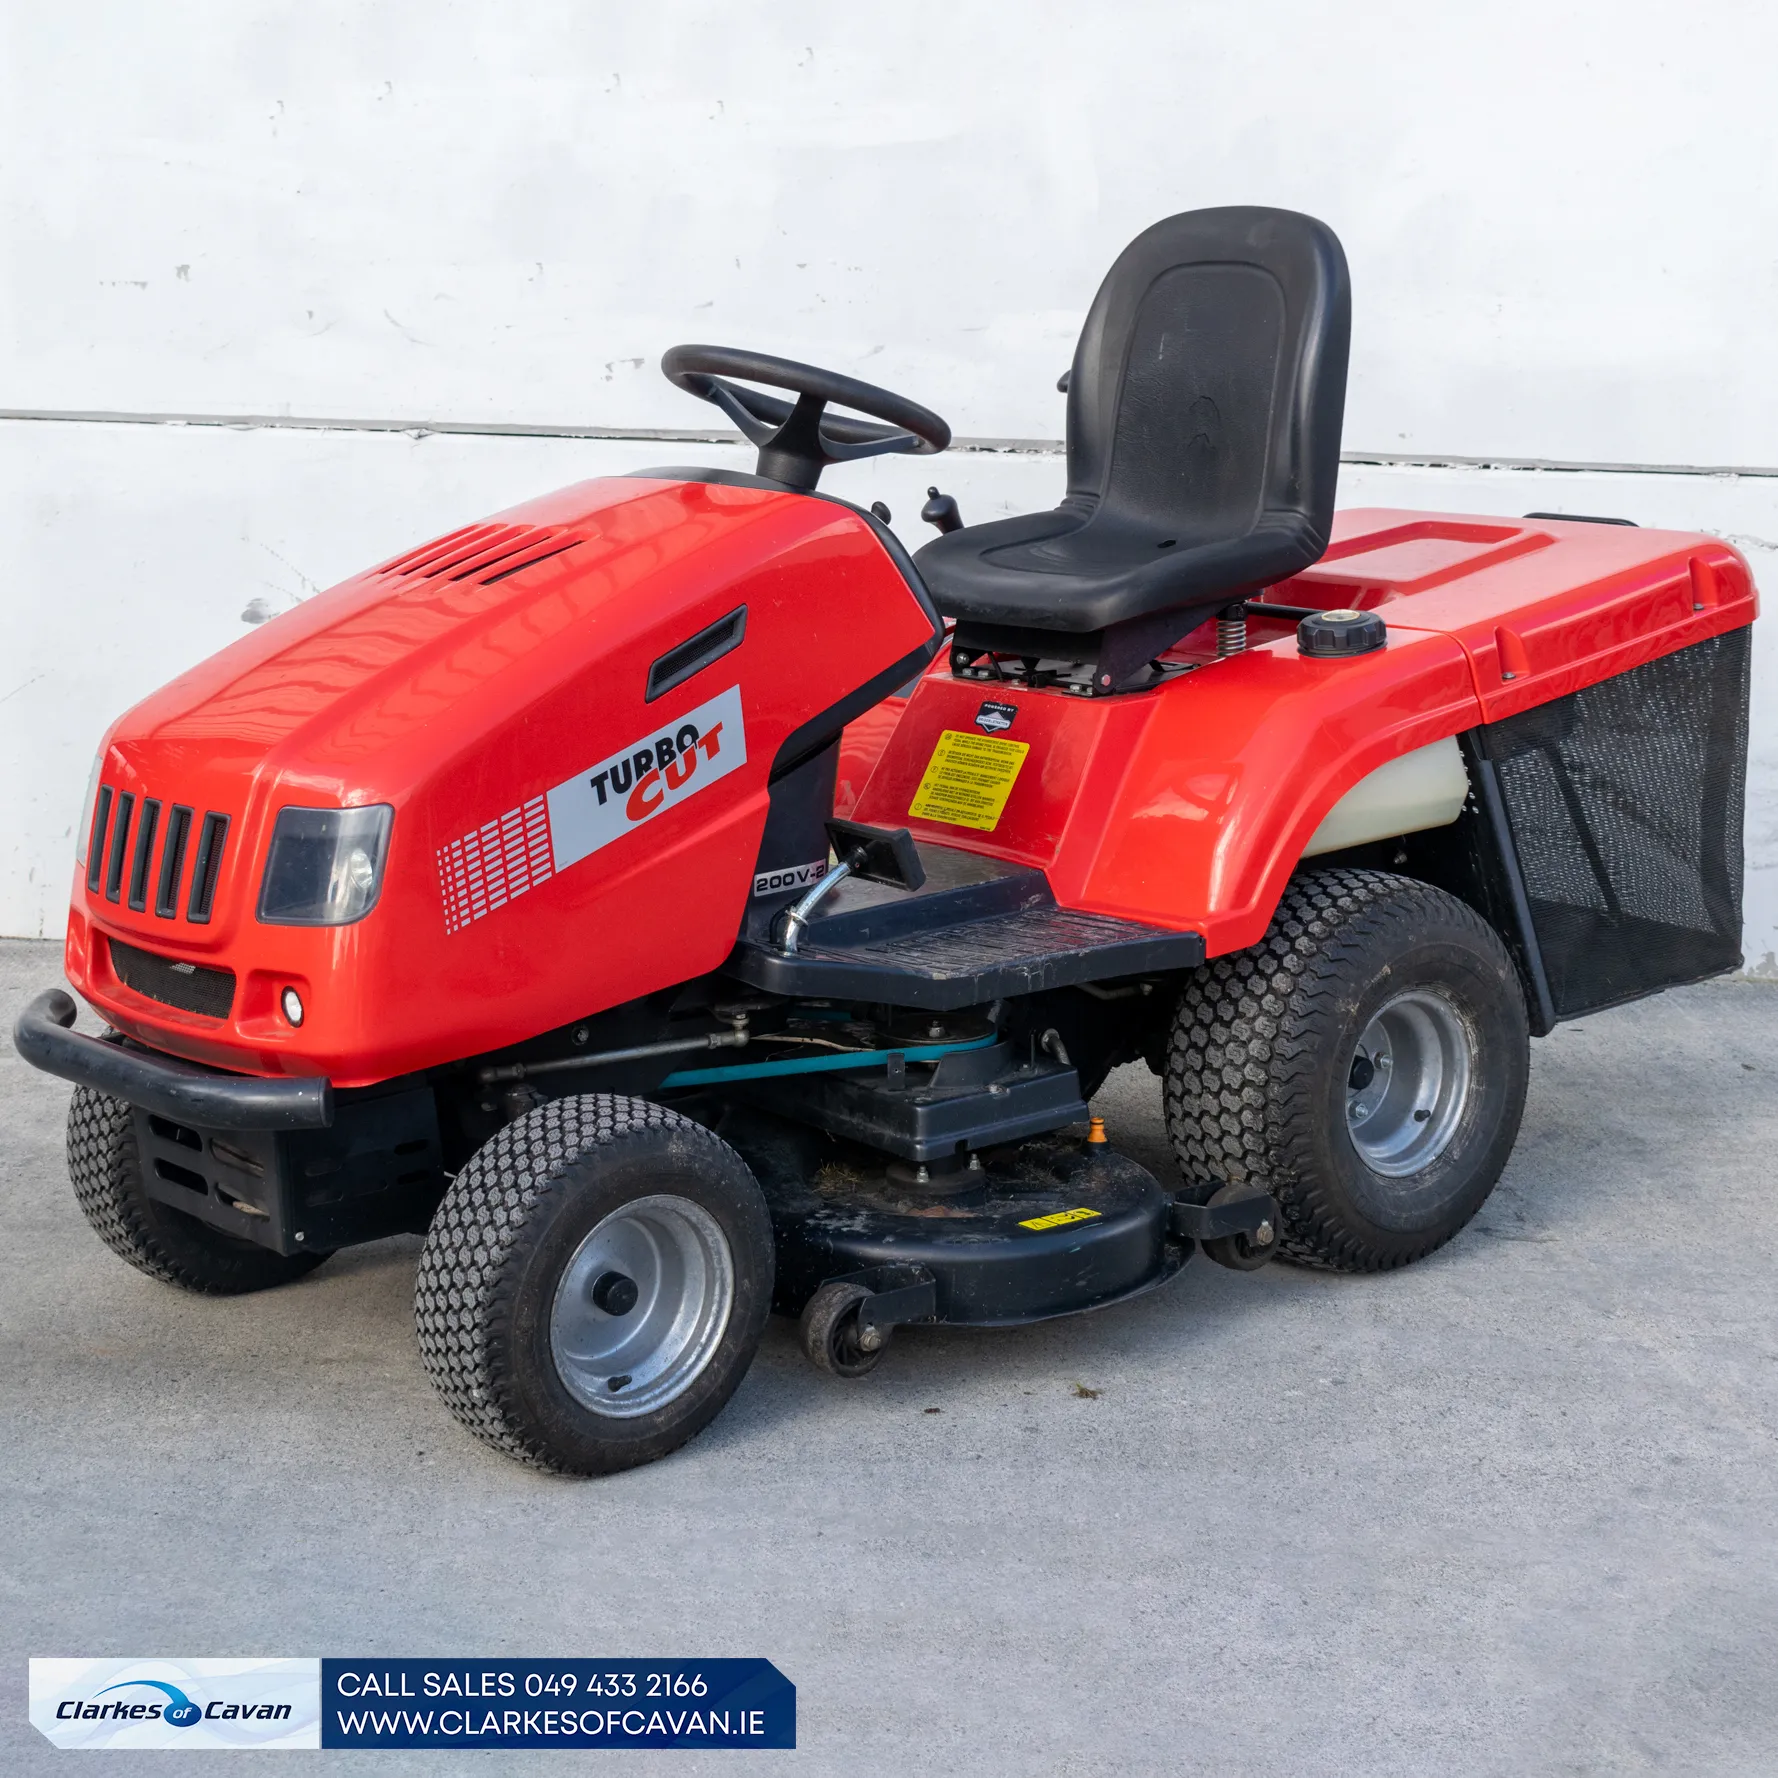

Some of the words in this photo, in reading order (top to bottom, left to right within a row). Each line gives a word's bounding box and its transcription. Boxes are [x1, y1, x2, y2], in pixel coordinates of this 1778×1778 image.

[984, 703, 1007, 711] POWERED
[590, 724, 699, 806] TURBO
[626, 721, 723, 822] CUT
